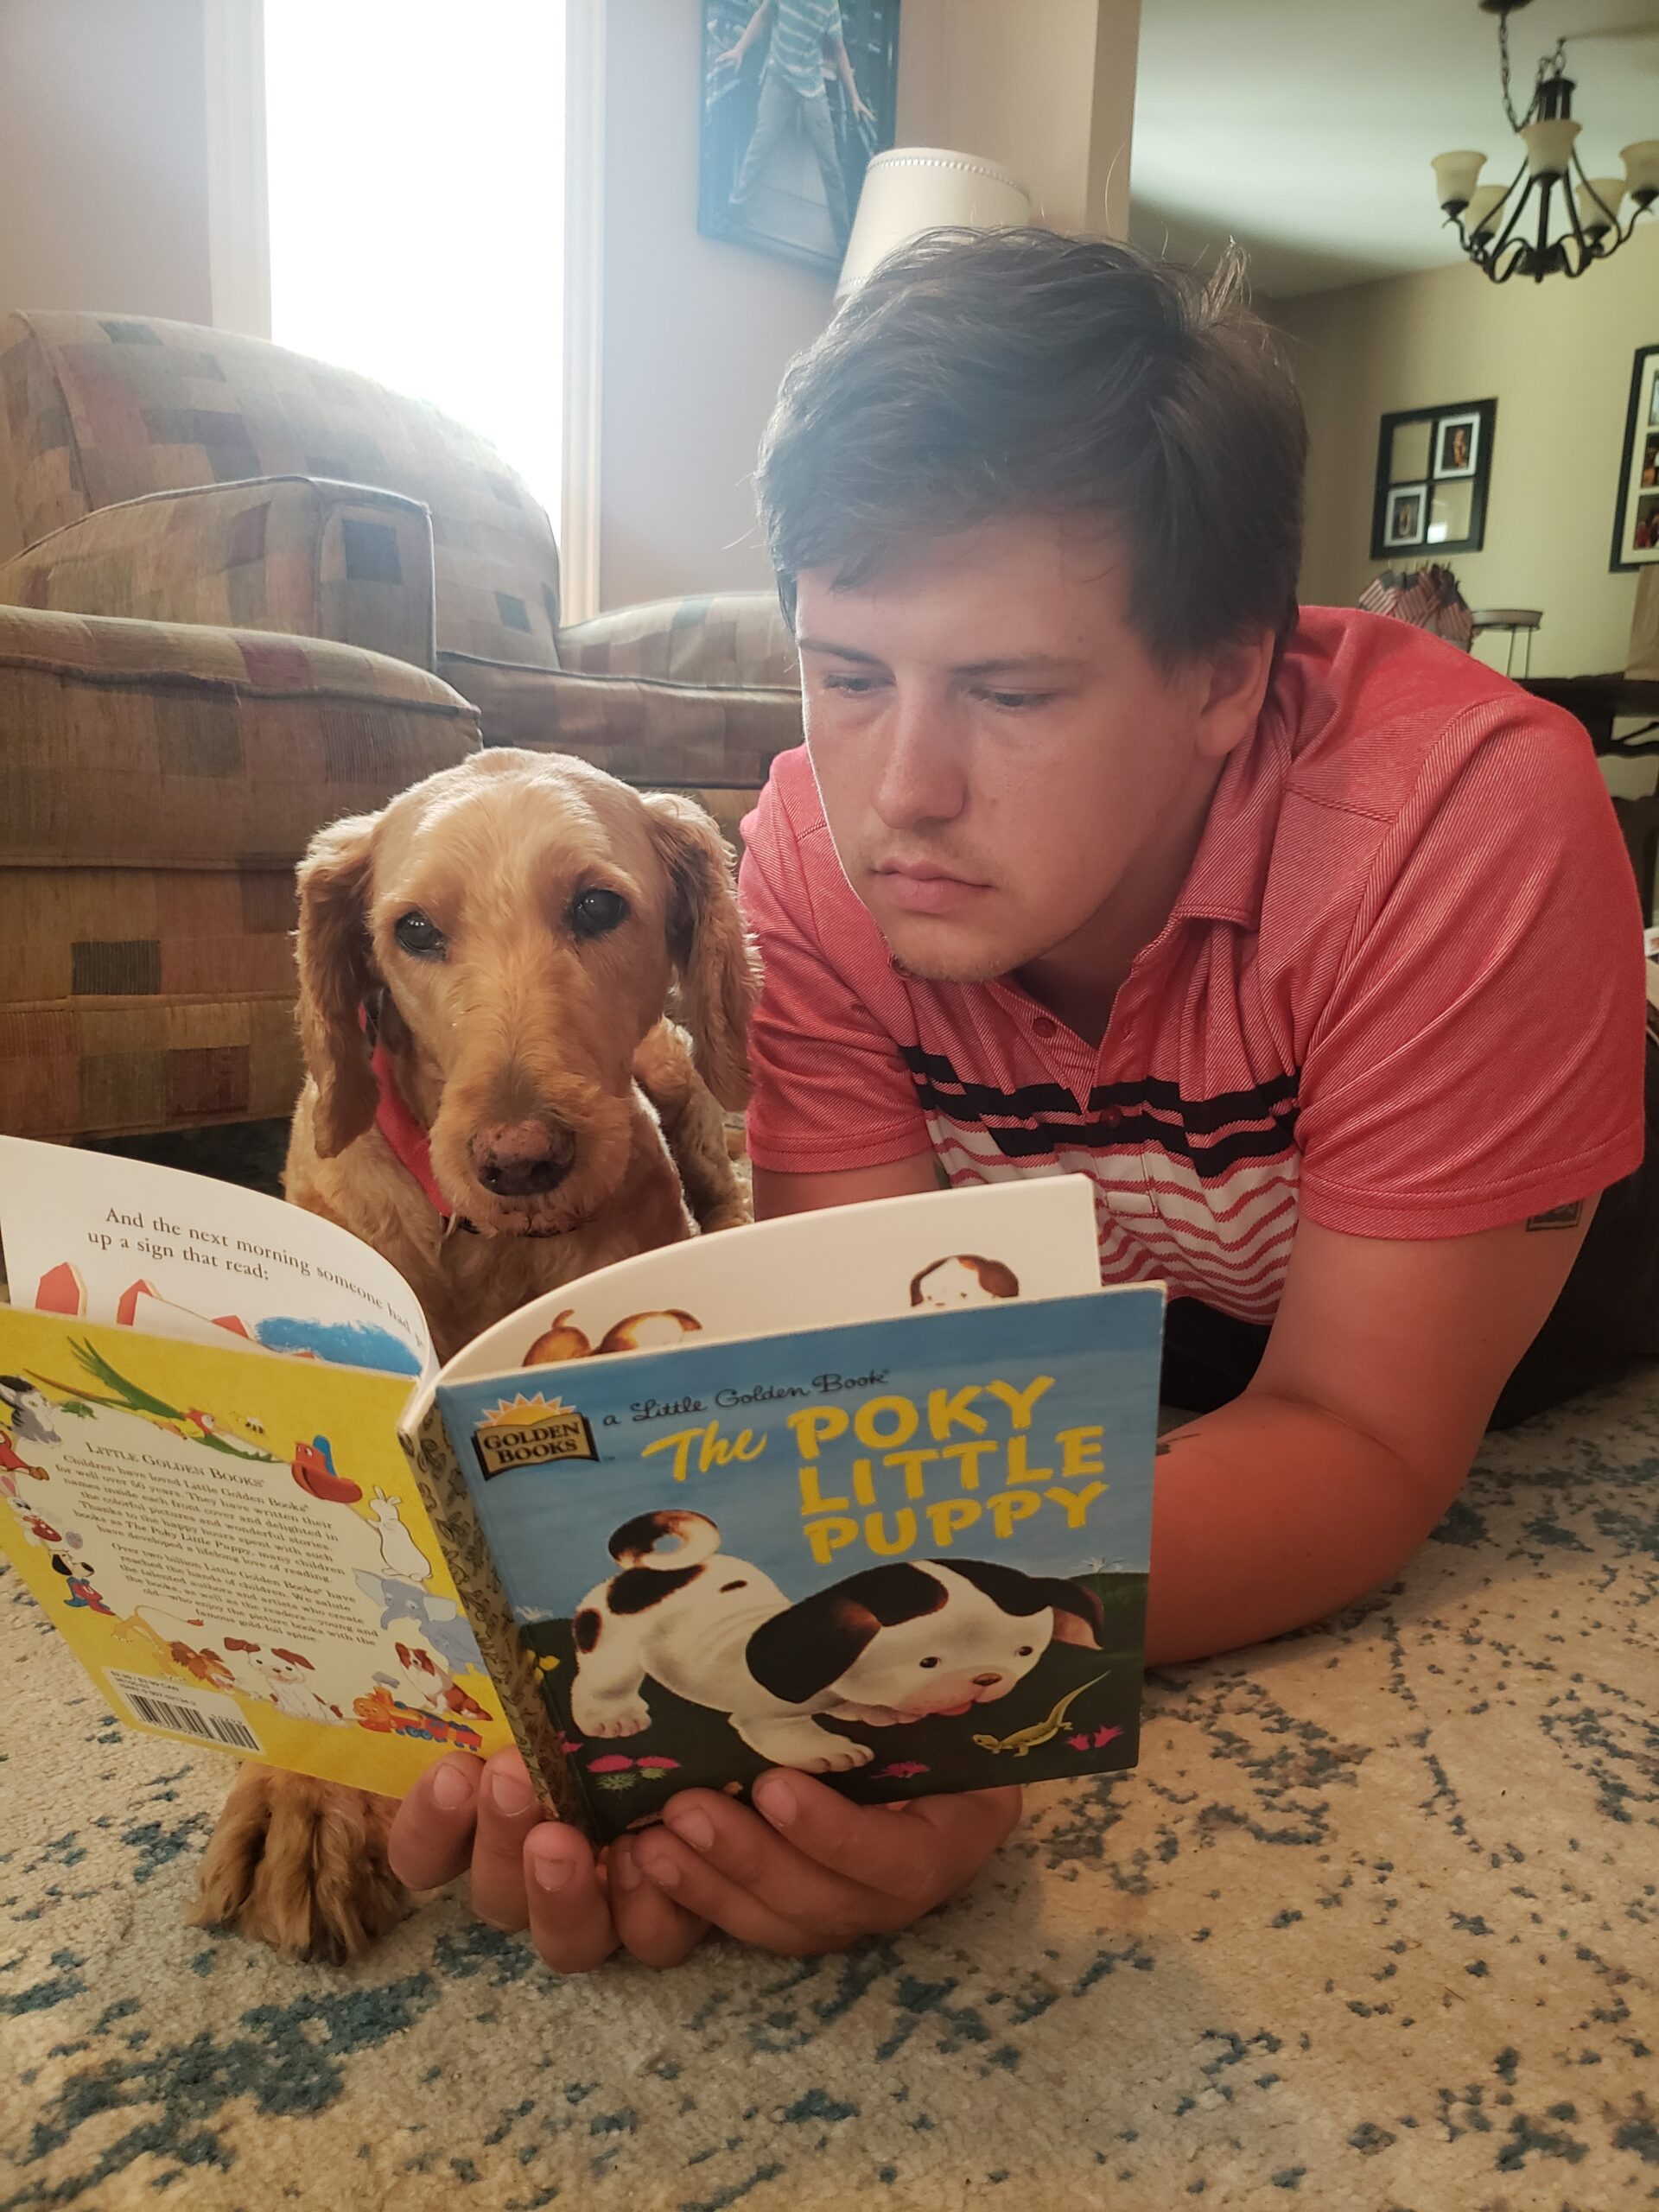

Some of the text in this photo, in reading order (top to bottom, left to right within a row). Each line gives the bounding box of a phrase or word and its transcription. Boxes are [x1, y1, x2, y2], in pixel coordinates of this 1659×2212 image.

[87, 1232, 270, 1281] up a sign that read:
[105, 1208, 410, 1333] And the next morning someone had
[603, 1414, 621, 1426] a
[630, 1397, 708, 1422] Little
[715, 1386, 810, 1408] Golden
[640, 1375, 1056, 1482] The POKY
[84, 1440, 140, 1463] LITTLE
[138, 1452, 207, 1477] GOLDEN
[483, 1421, 580, 1451] GOLDEN
[497, 1440, 578, 1465] BOOKS
[798, 1426, 1105, 1516] LITTLE
[803, 1481, 1109, 1564] PUPPY
